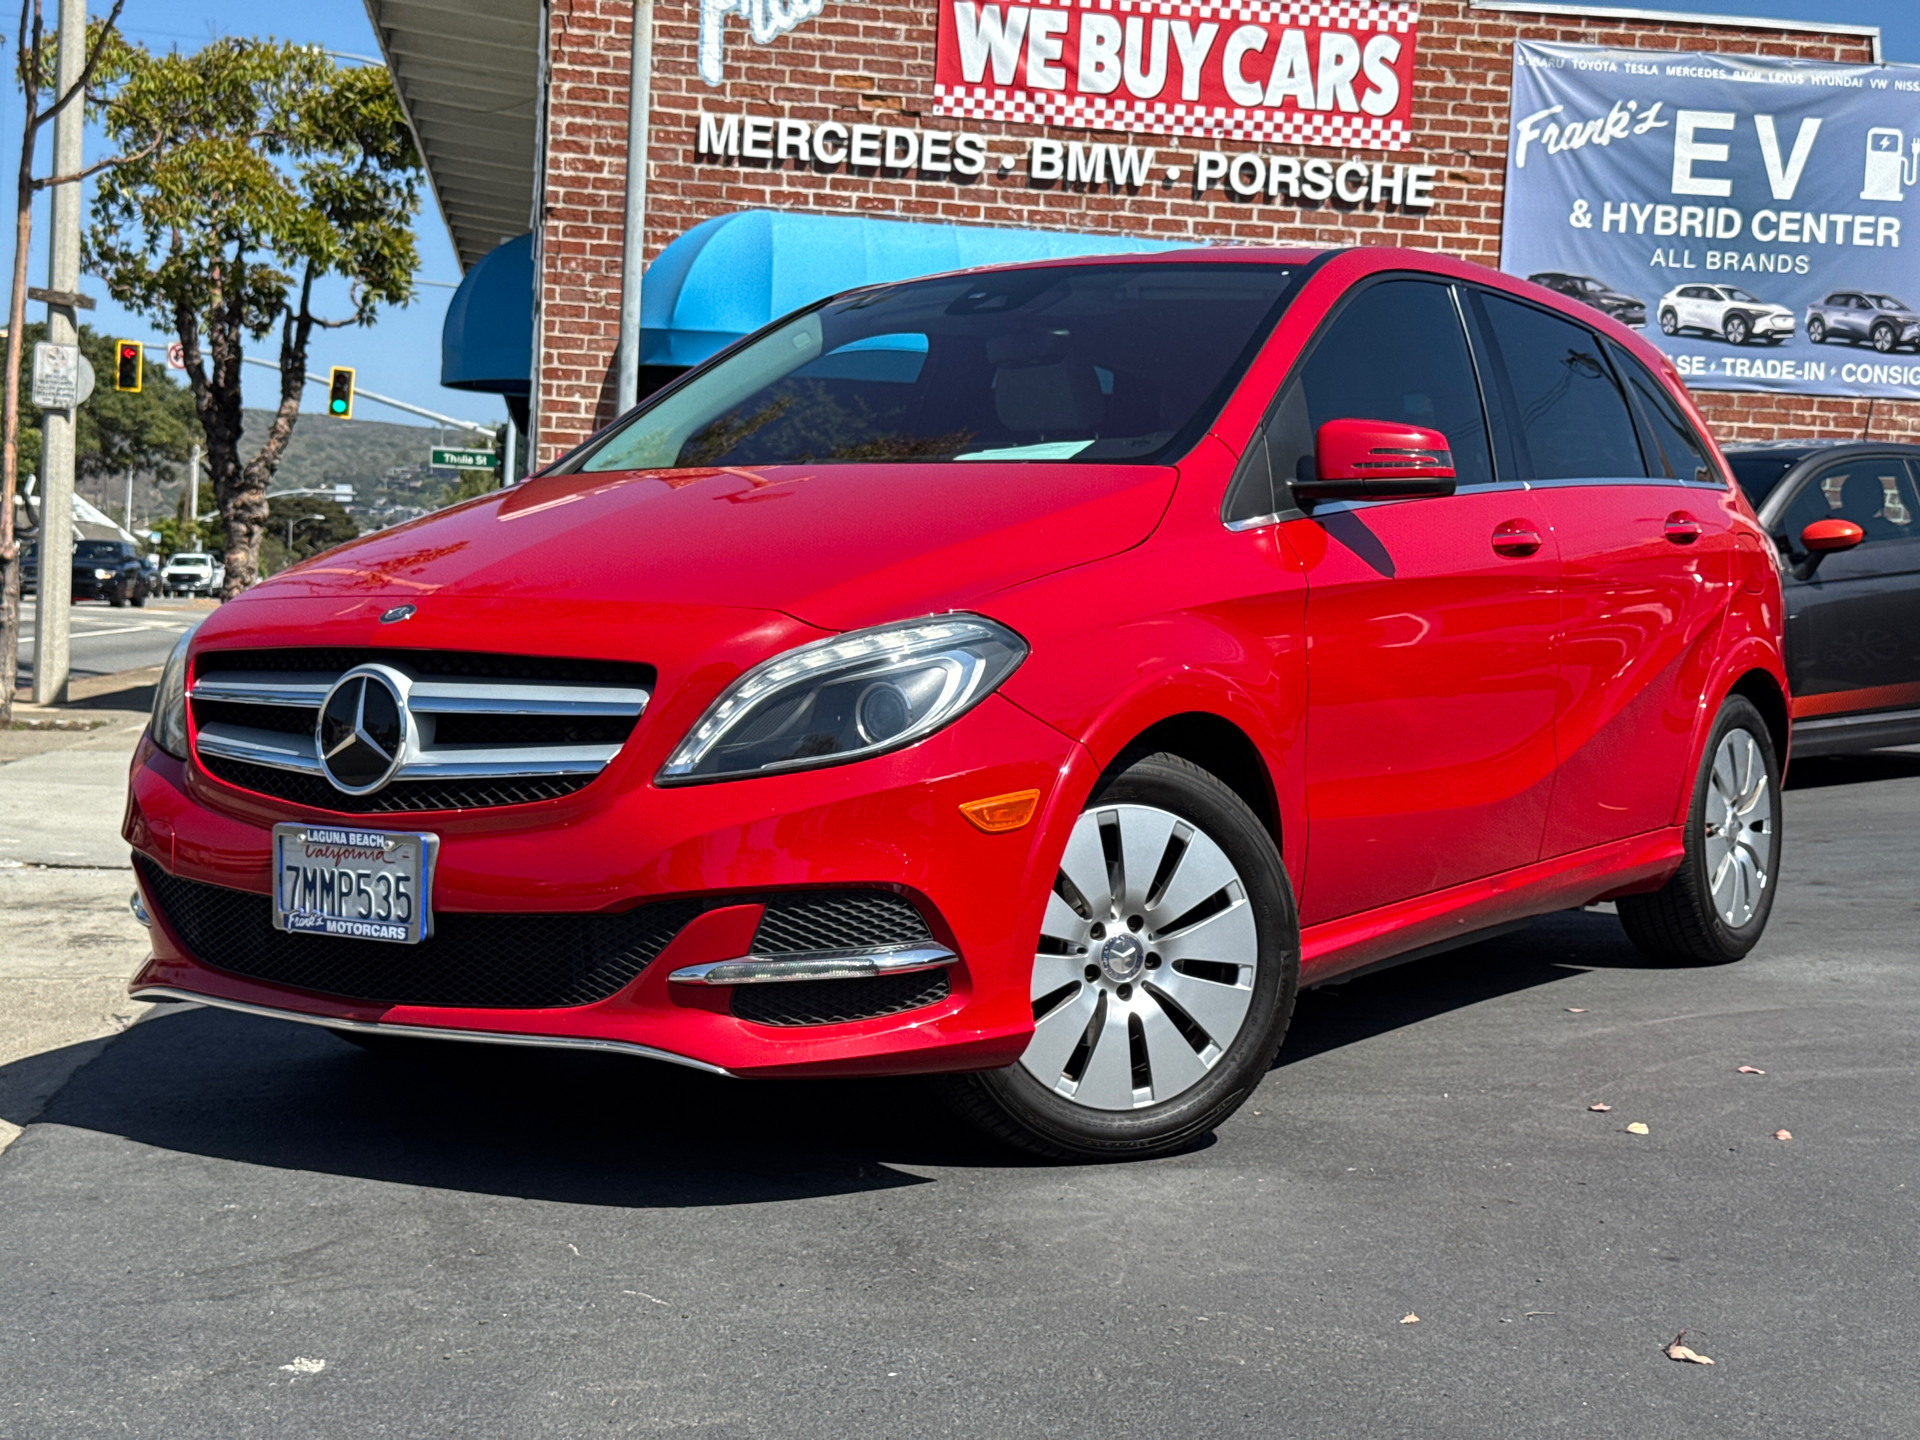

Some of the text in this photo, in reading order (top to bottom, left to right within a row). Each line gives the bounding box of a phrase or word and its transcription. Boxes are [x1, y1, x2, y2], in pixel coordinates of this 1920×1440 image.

[953, 1, 1403, 117] WE BUY CARS
[1517, 54, 1566, 69] SBARU
[1573, 59, 1617, 73] TOYOTA
[1625, 63, 1659, 76] TESLA
[1665, 66, 1727, 81] MERCEDES
[1768, 72, 1805, 85] LEXUS
[1811, 75, 1863, 88] HYUNDAI
[1870, 78, 1889, 90] VW
[1894, 80, 1920, 92] NISS
[1516, 99, 1669, 169] Frank's
[698, 112, 1437, 207] MERCEDES BMW PORSCHE
[1569, 198, 1902, 248] & HYBRID CENTER
[1650, 248, 1810, 275] ALL BRANDS
[1667, 354, 1706, 376] SE
[1721, 357, 1825, 381] TRADE-IN
[475, 455, 487, 466] St
[306, 829, 385, 848] LAGUNA BEACH
[286, 865, 412, 924] 7MMP535
[326, 920, 406, 940] MOTORCARS
